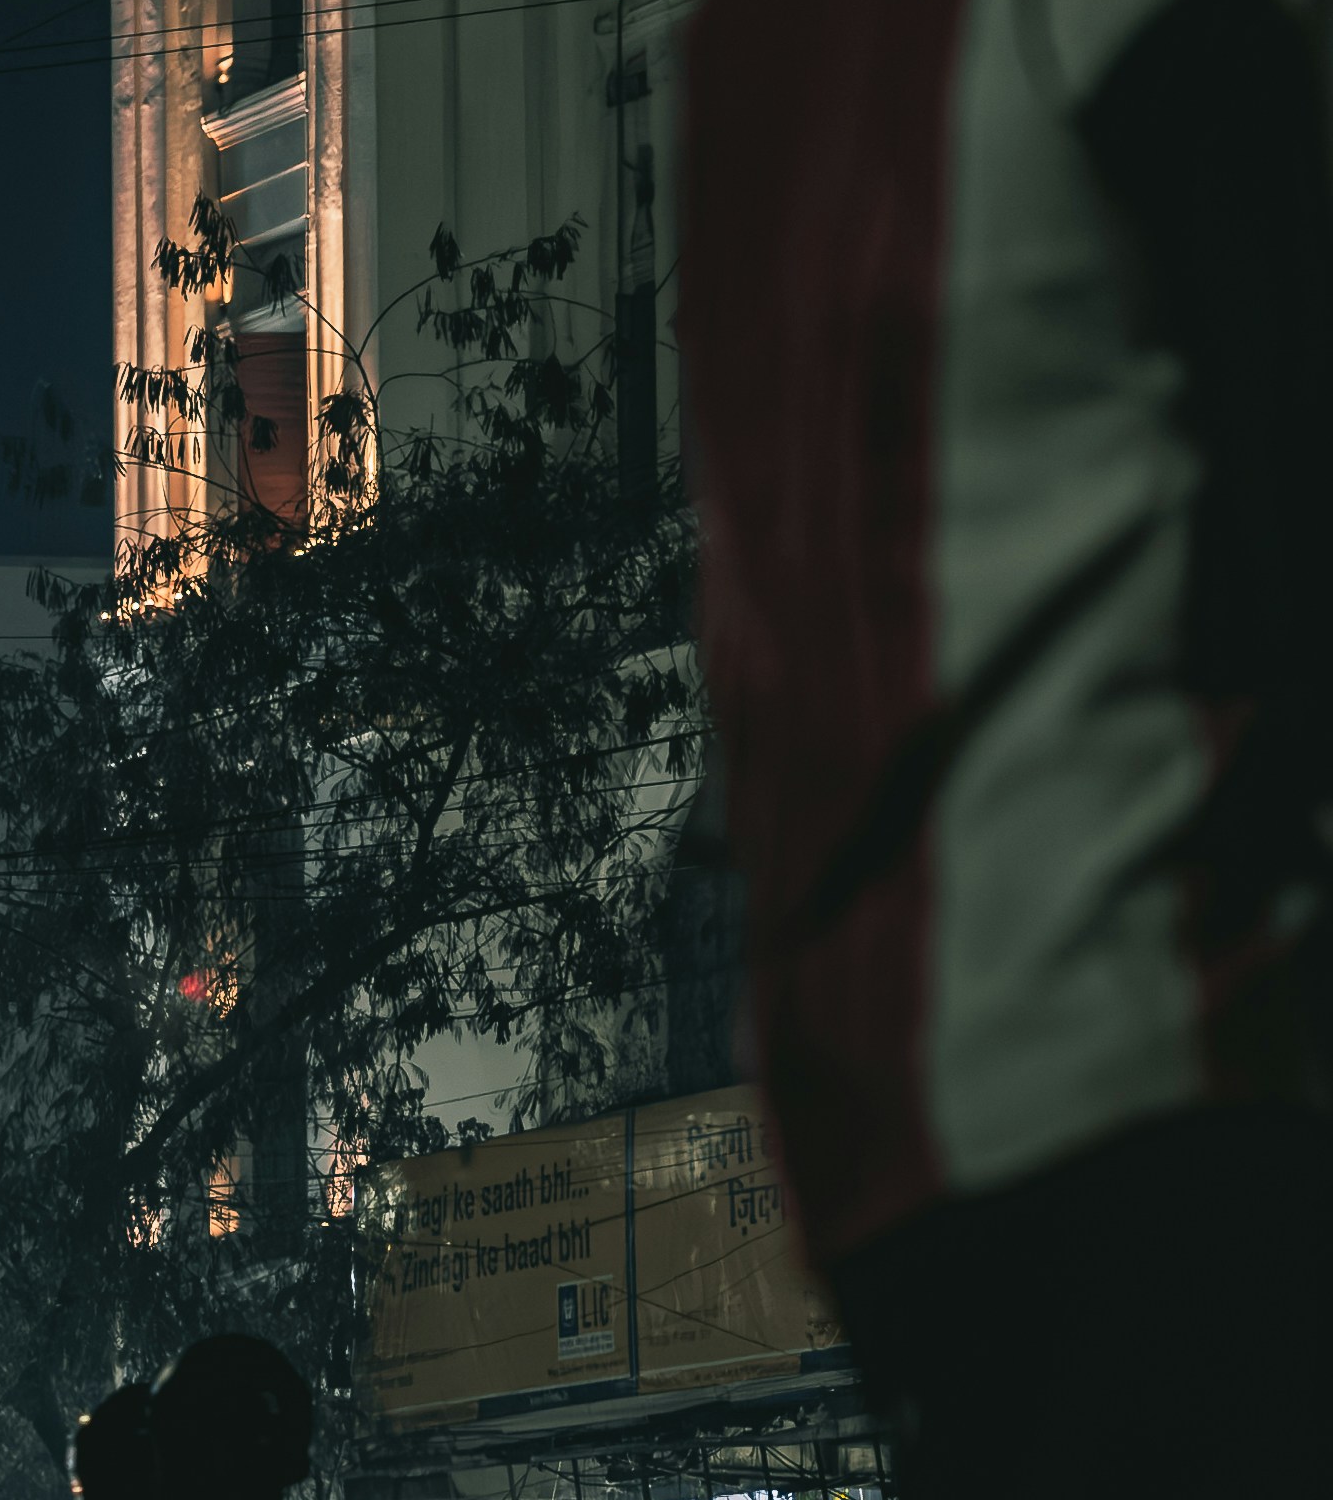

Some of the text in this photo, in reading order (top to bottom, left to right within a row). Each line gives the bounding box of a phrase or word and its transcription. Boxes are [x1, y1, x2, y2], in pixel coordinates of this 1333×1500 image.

[452, 1182, 475, 1222] ke
[480, 1167, 534, 1216] saath
[400, 1219, 591, 1291] Zindagi ke baad bhi
[580, 1283, 612, 1329] LIC
